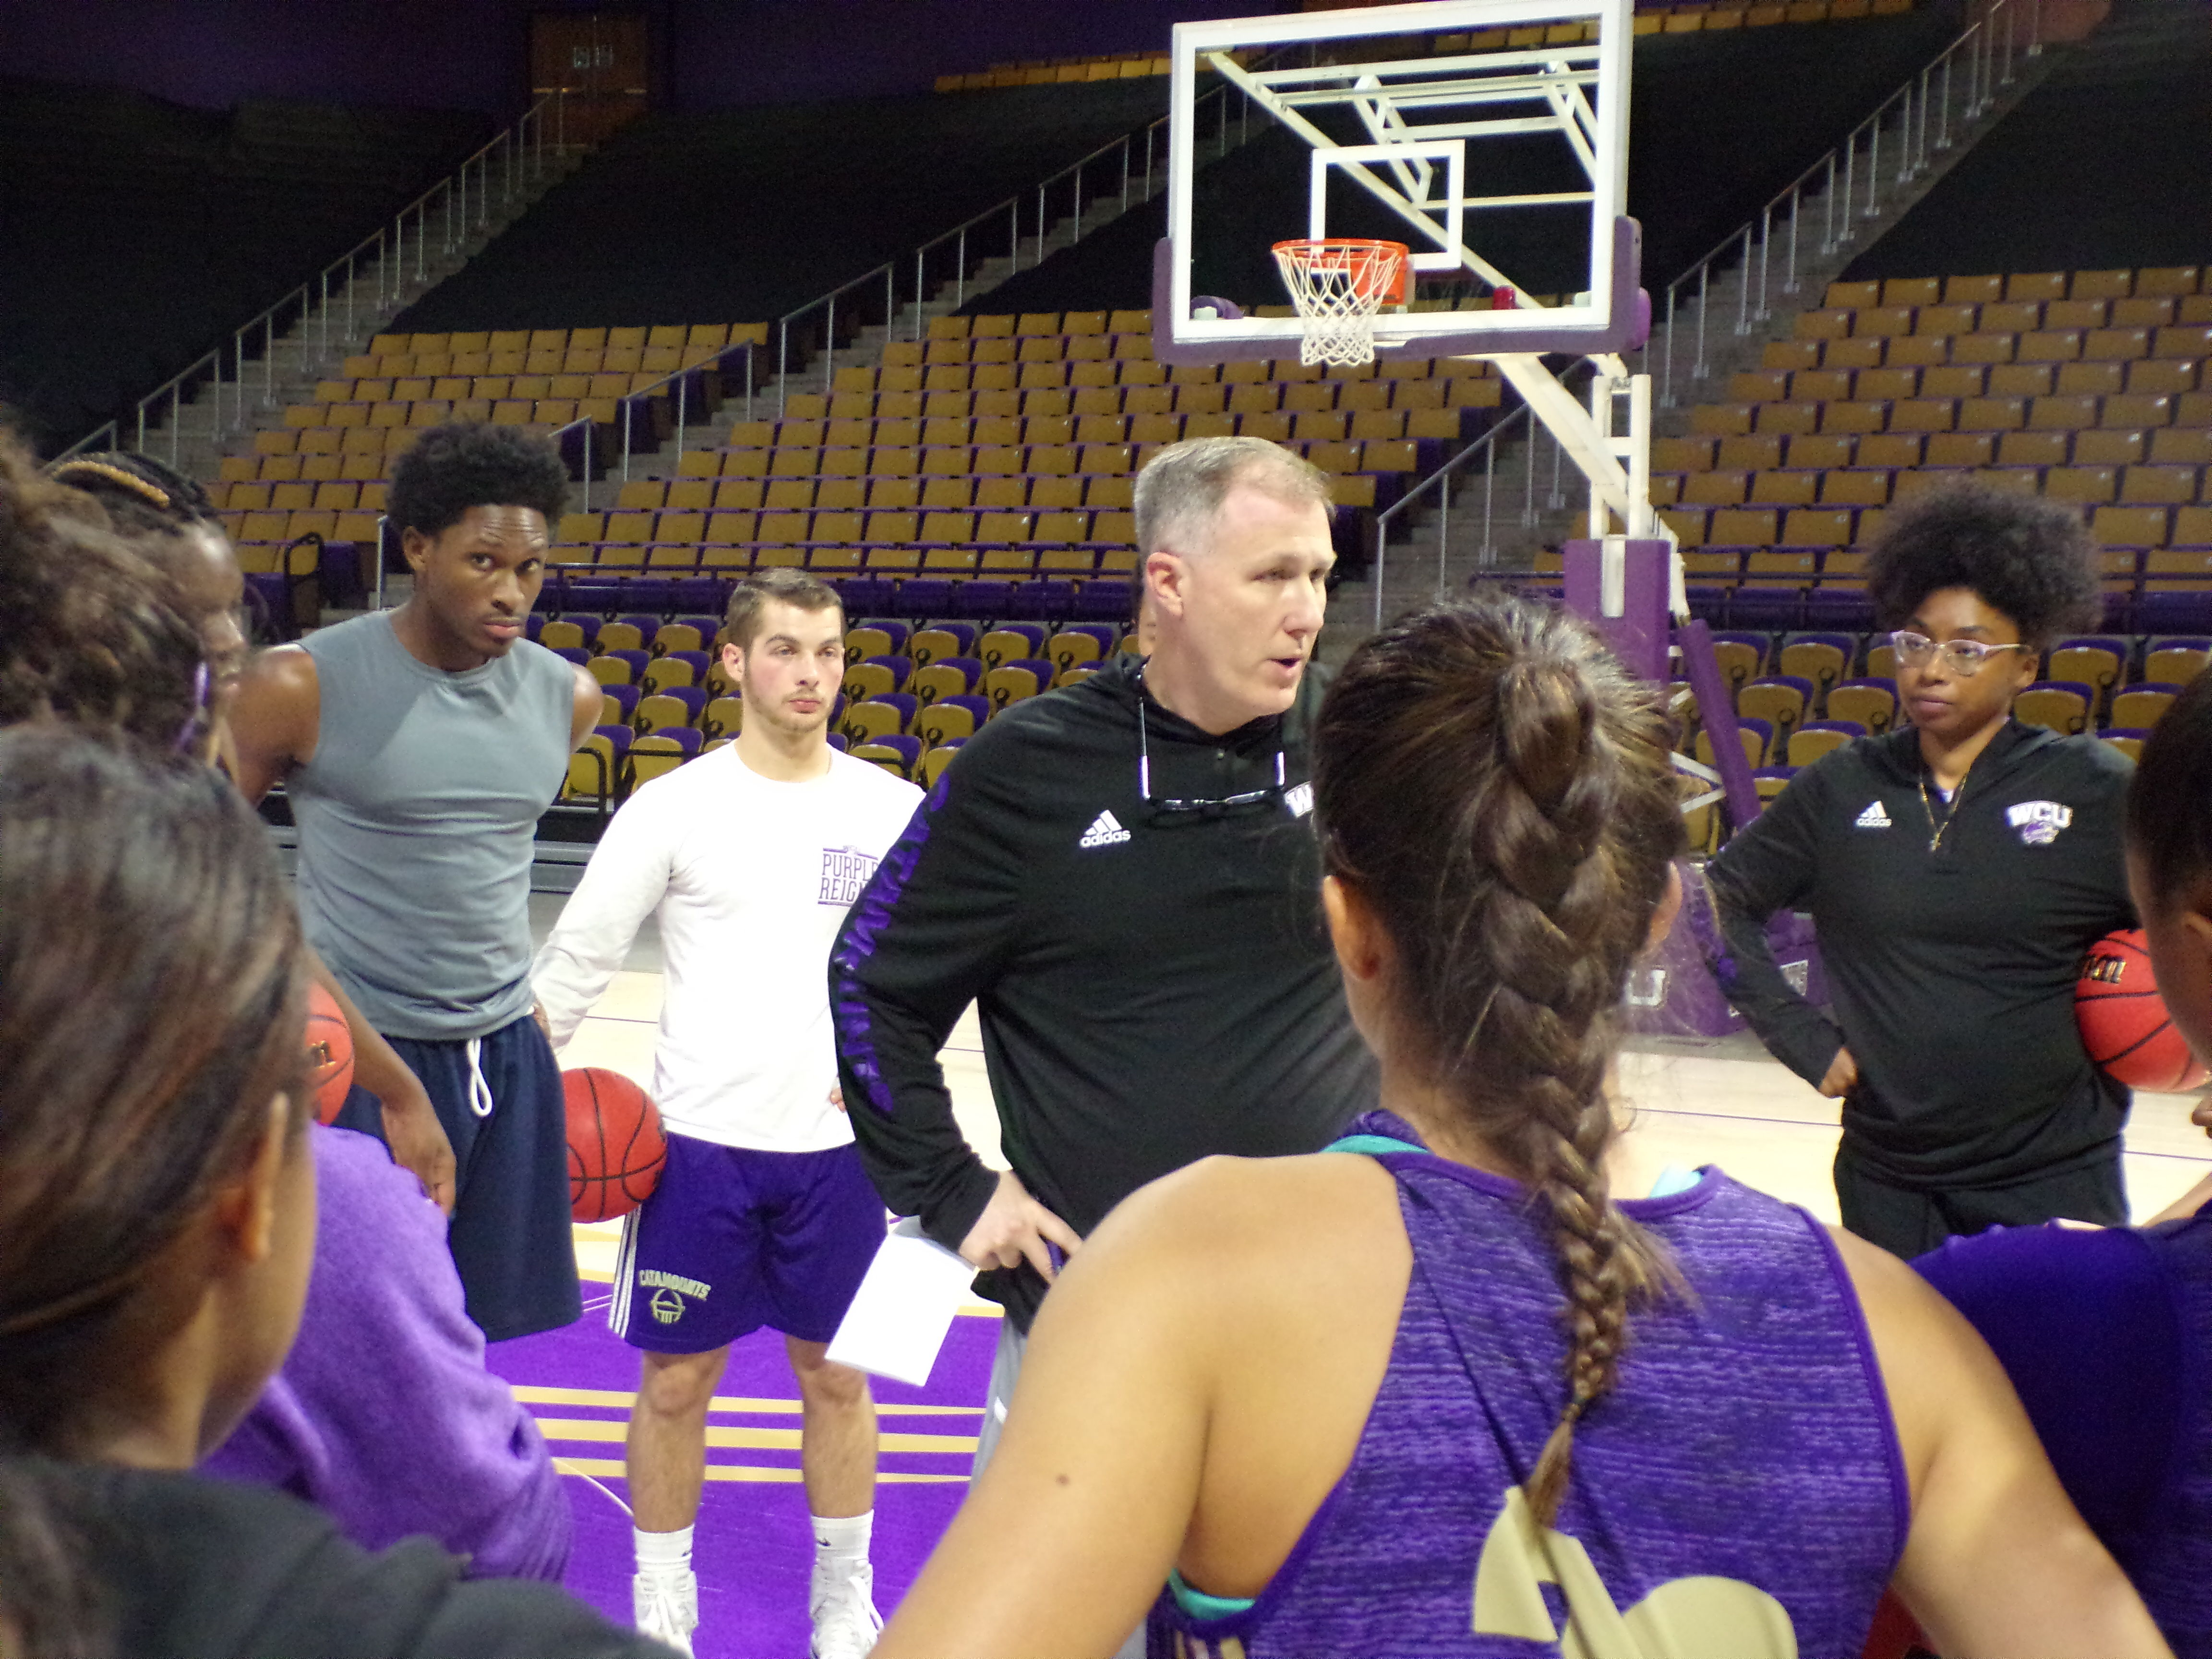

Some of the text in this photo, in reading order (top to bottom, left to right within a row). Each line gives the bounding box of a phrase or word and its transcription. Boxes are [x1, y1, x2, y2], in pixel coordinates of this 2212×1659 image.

[1856, 817, 1892, 828] adidas
[2008, 801, 2072, 828] WCU
[1080, 830, 1130, 847] adidas
